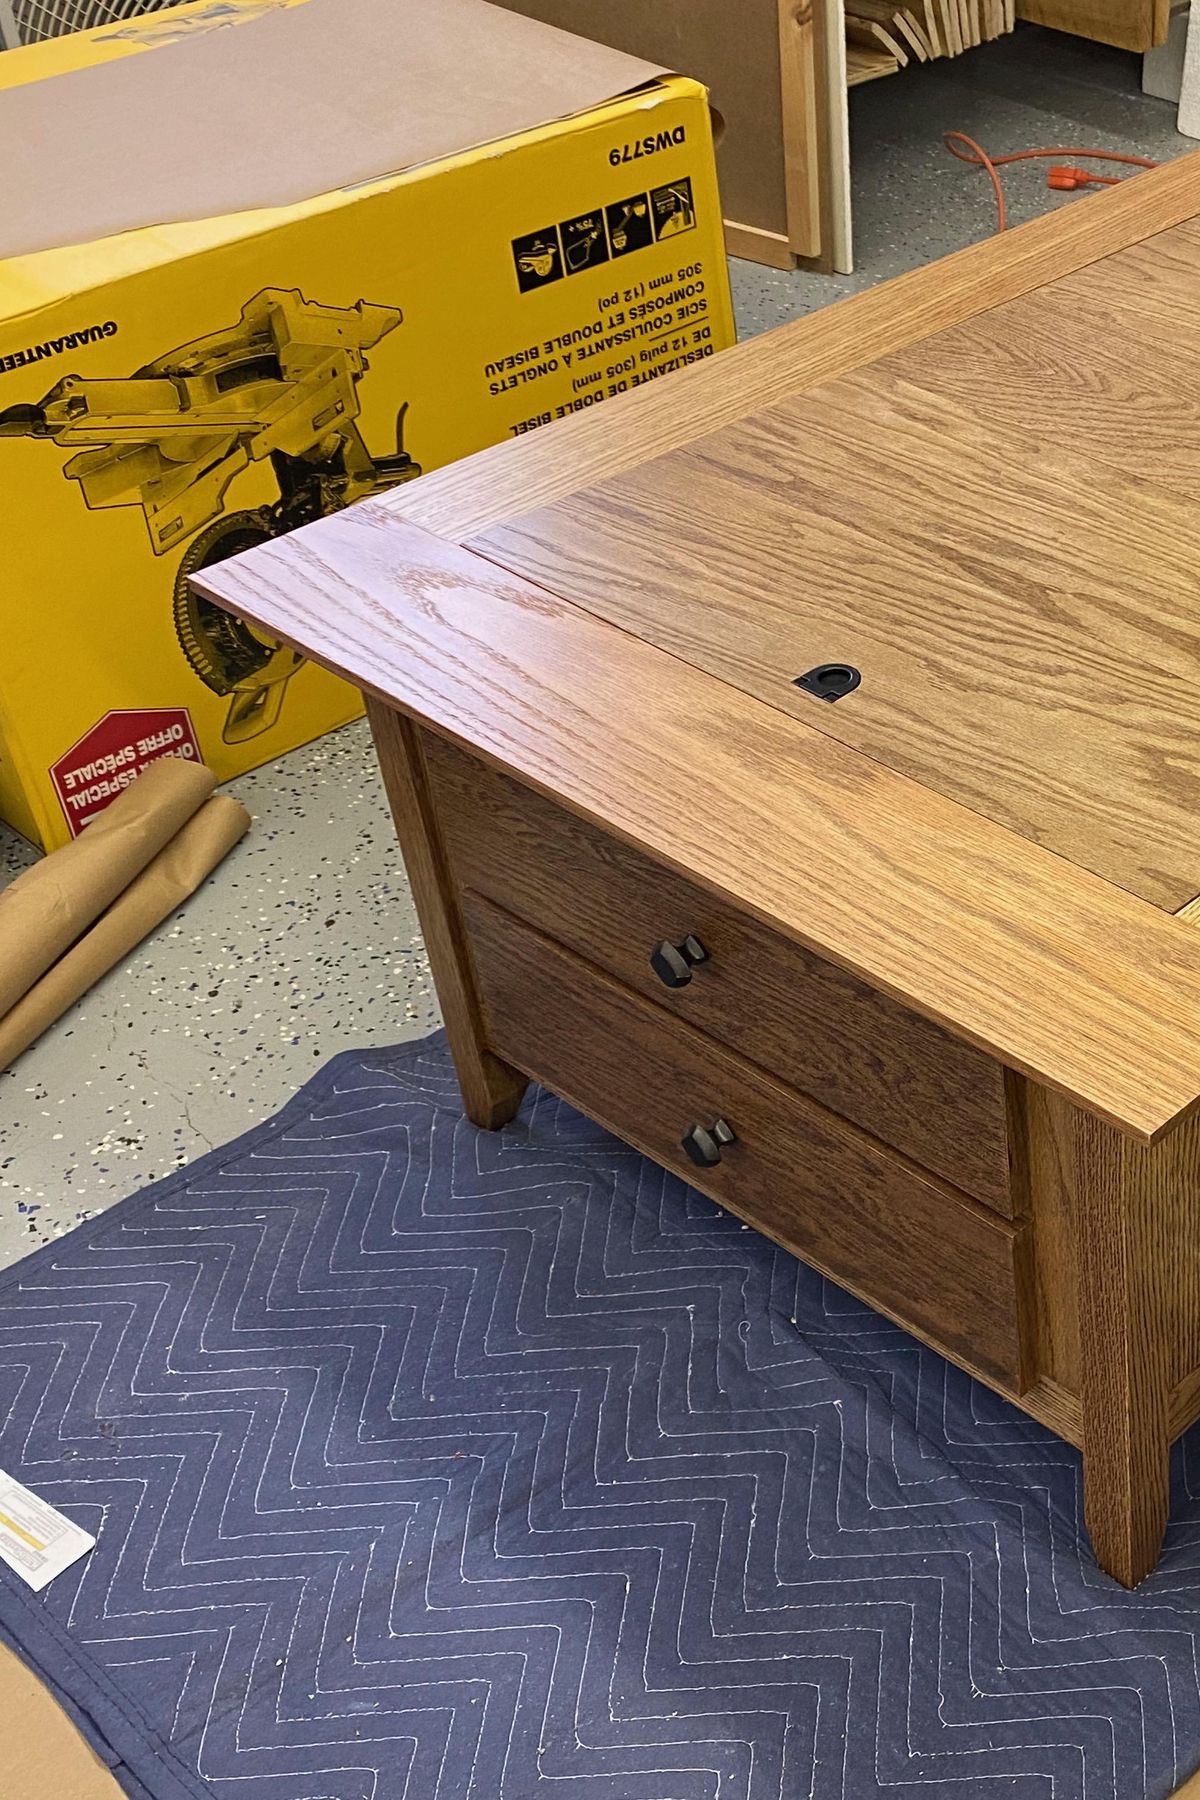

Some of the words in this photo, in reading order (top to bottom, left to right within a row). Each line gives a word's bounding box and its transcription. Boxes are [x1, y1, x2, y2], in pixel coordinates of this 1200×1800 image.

[609, 126, 685, 166] DWS779
[648, 273, 673, 290] mm
[677, 263, 702, 281] 305
[598, 292, 619, 313] po)
[623, 282, 645, 302] (12
[629, 281, 704, 320] COMPOSÉS
[607, 312, 625, 330] ET
[676, 299, 707, 320] SCIE
[543, 320, 603, 354] DOUBLE
[576, 313, 672, 360] COULISSANTE
[672, 336, 688, 351] 12
[692, 326, 711, 342] DE
[485, 346, 539, 378] BISEAU
[561, 352, 572, 368] À
[640, 341, 668, 362] pulg
[489, 359, 558, 396] ONGLETS
[606, 354, 636, 379] (305
[632, 344, 714, 388] DESLIZANTE
[572, 371, 602, 392] mm)
[608, 380, 627, 398] DE
[556, 389, 604, 419] DOBLE
[509, 411, 552, 437] BISEL
[136, 724, 184, 756] OFFRE
[63, 746, 136, 789] SPÉCIALE
[66, 768, 138, 810] ESPECIAL
